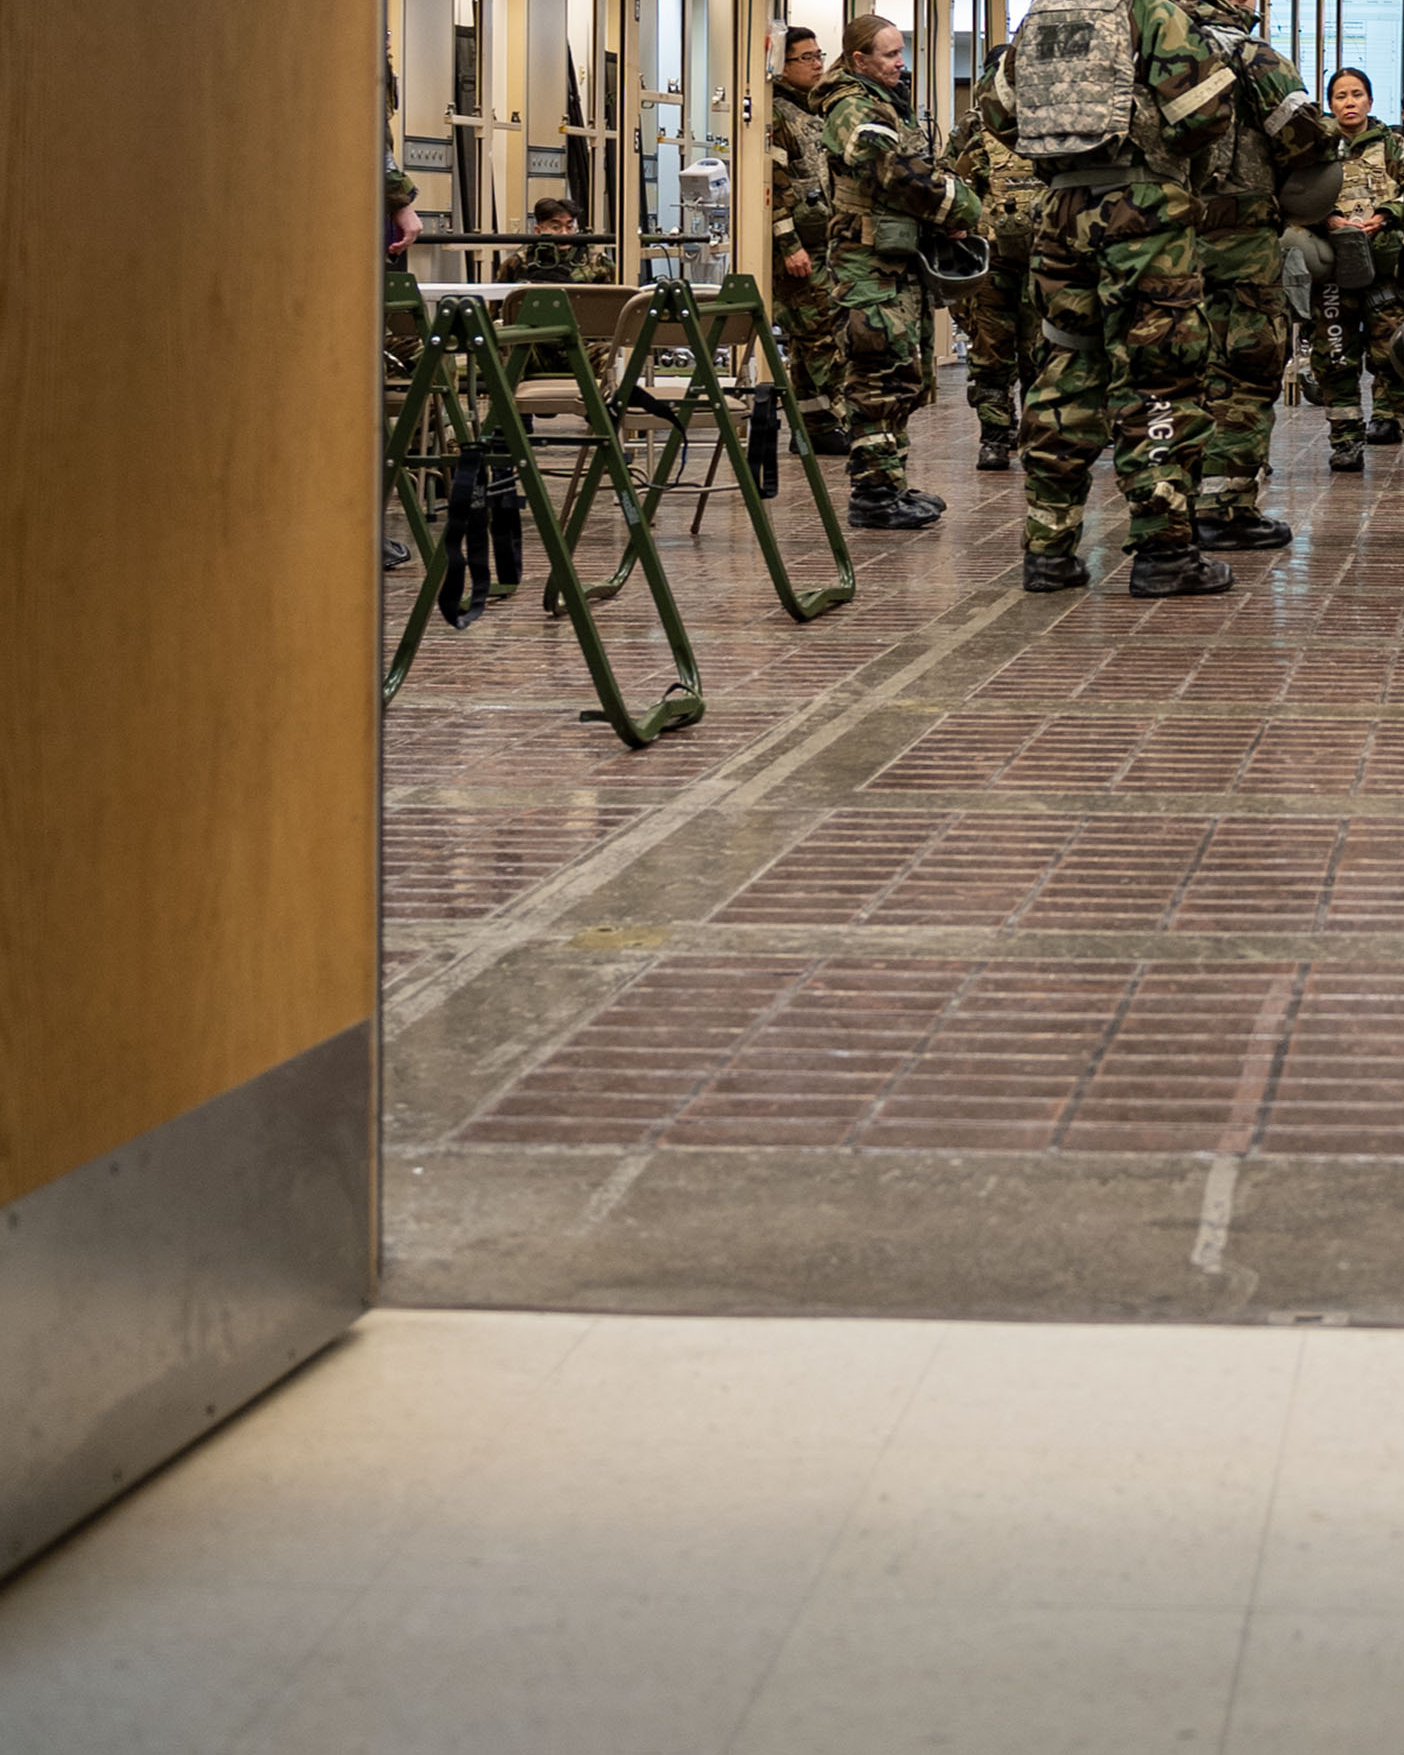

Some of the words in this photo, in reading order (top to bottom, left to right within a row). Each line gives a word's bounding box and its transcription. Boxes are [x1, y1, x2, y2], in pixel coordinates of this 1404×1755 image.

[1323, 283, 1340, 319] RNG
[1327, 324, 1347, 365] ONLY
[1145, 394, 1174, 440] RNG
